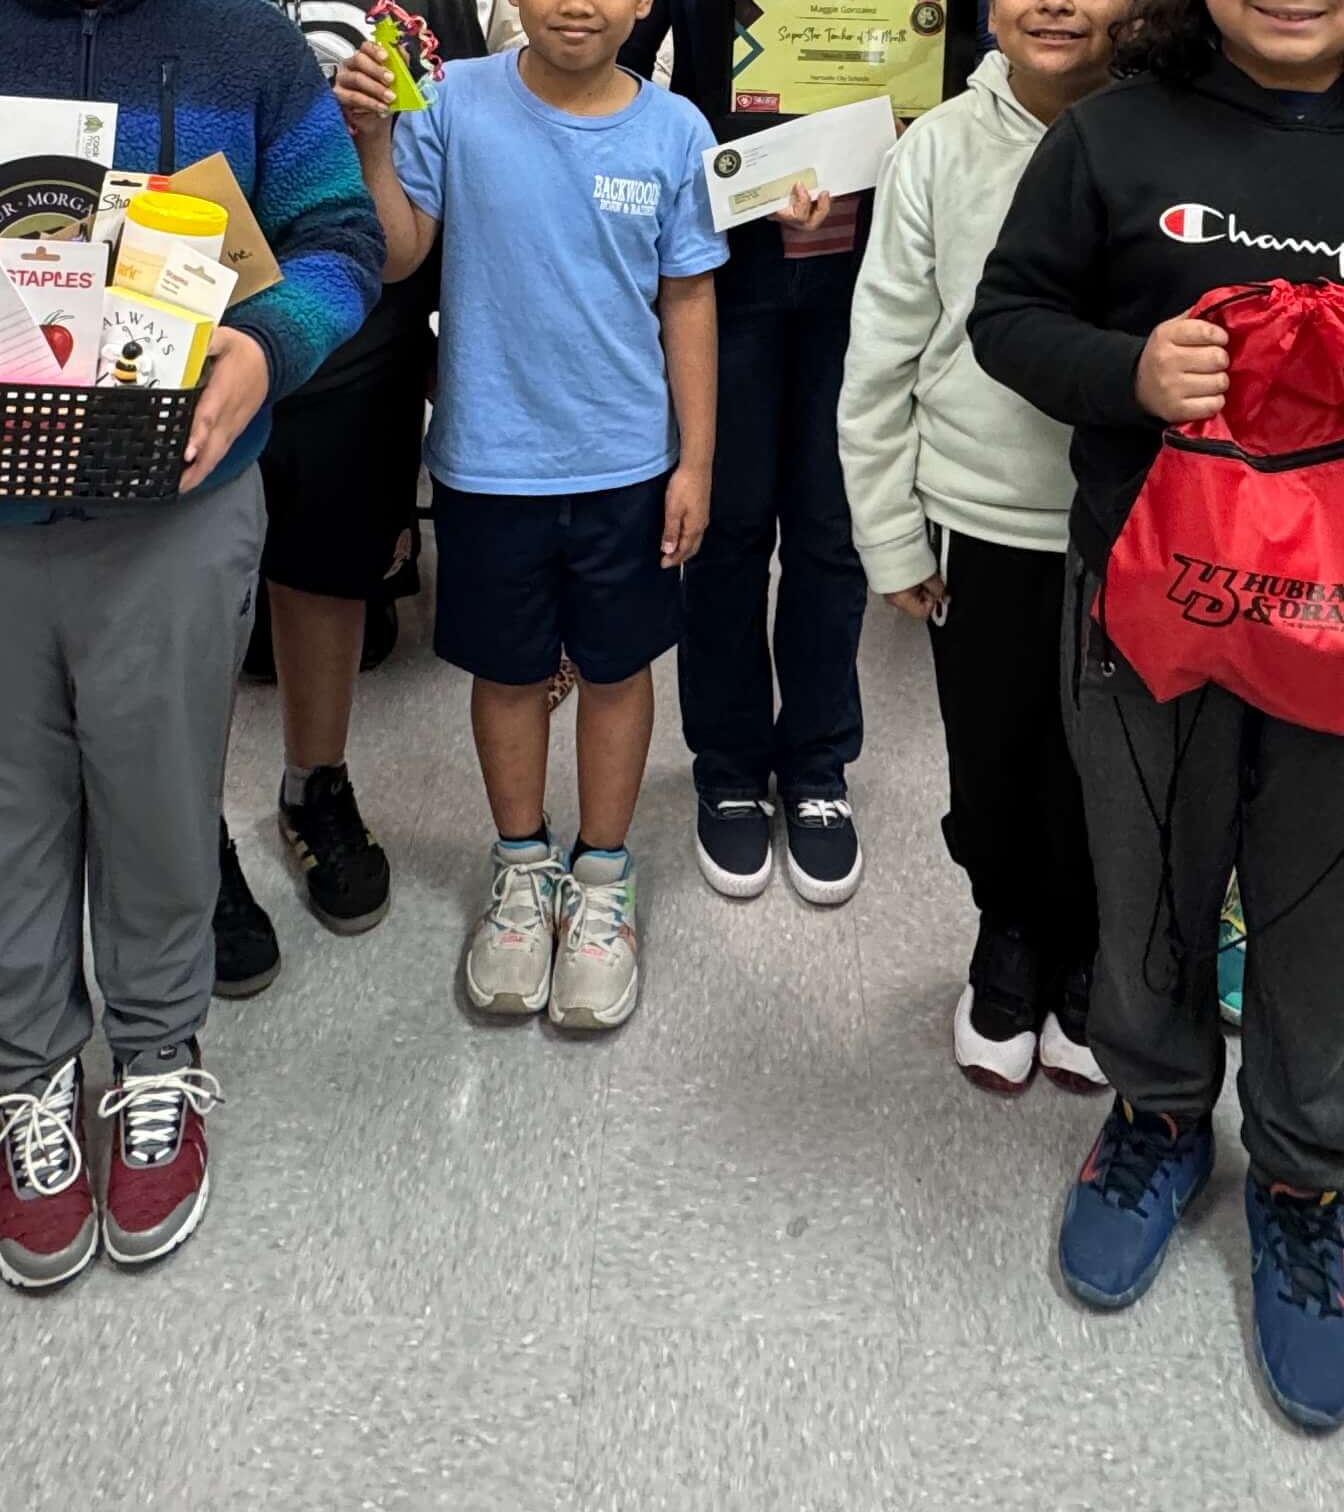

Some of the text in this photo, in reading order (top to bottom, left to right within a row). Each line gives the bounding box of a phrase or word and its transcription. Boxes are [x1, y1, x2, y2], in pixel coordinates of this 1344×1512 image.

[7, 269, 94, 290] STAPLES
[103, 311, 176, 356] ALWAYS
[1243, 595, 1277, 626] &
